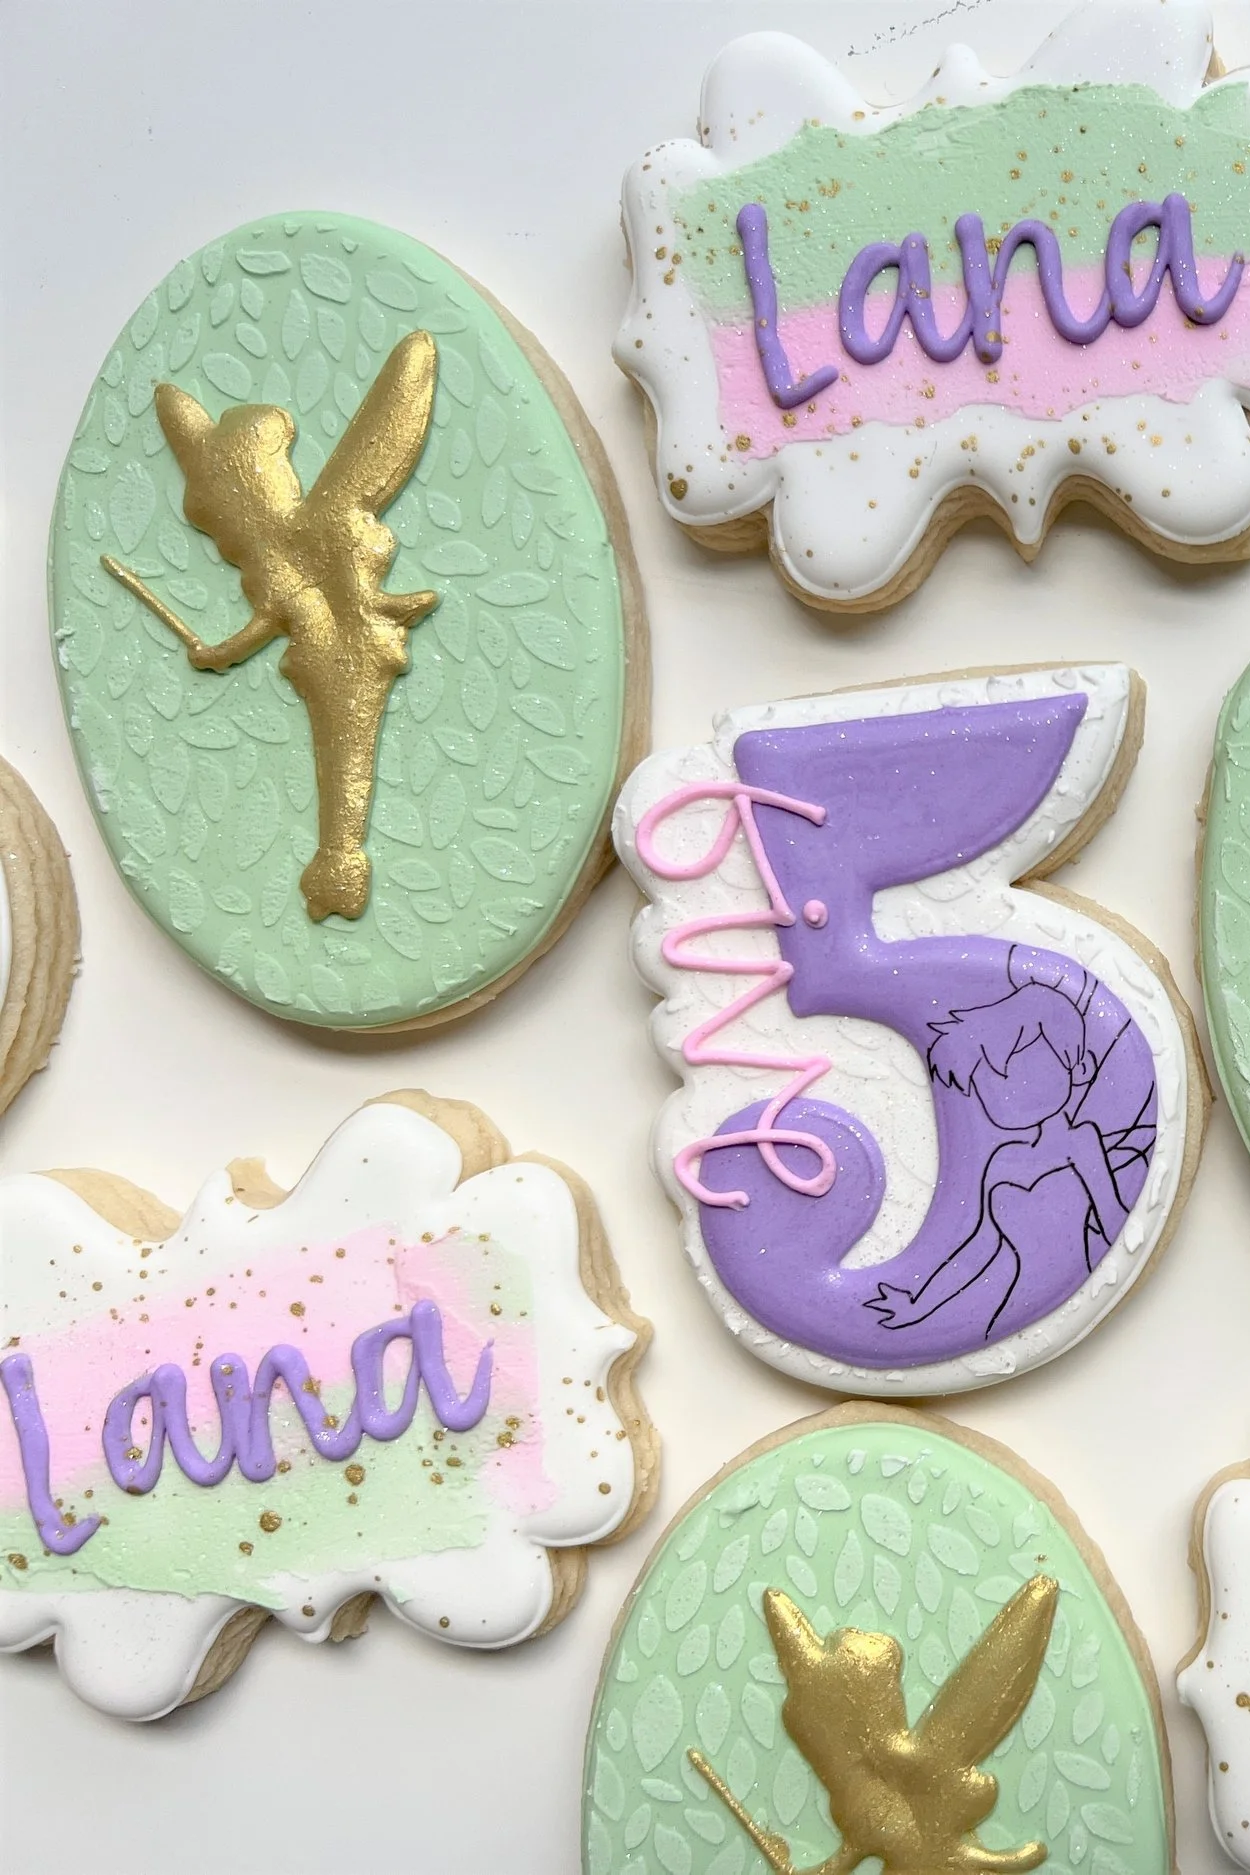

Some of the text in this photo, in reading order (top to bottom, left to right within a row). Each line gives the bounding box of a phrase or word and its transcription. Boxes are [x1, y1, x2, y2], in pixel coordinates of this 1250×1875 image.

[736, 193, 1245, 410] Lana
[635, 781, 829, 1209] five
[700, 692, 1158, 1369] 5
[0, 1299, 494, 1555] Lana
